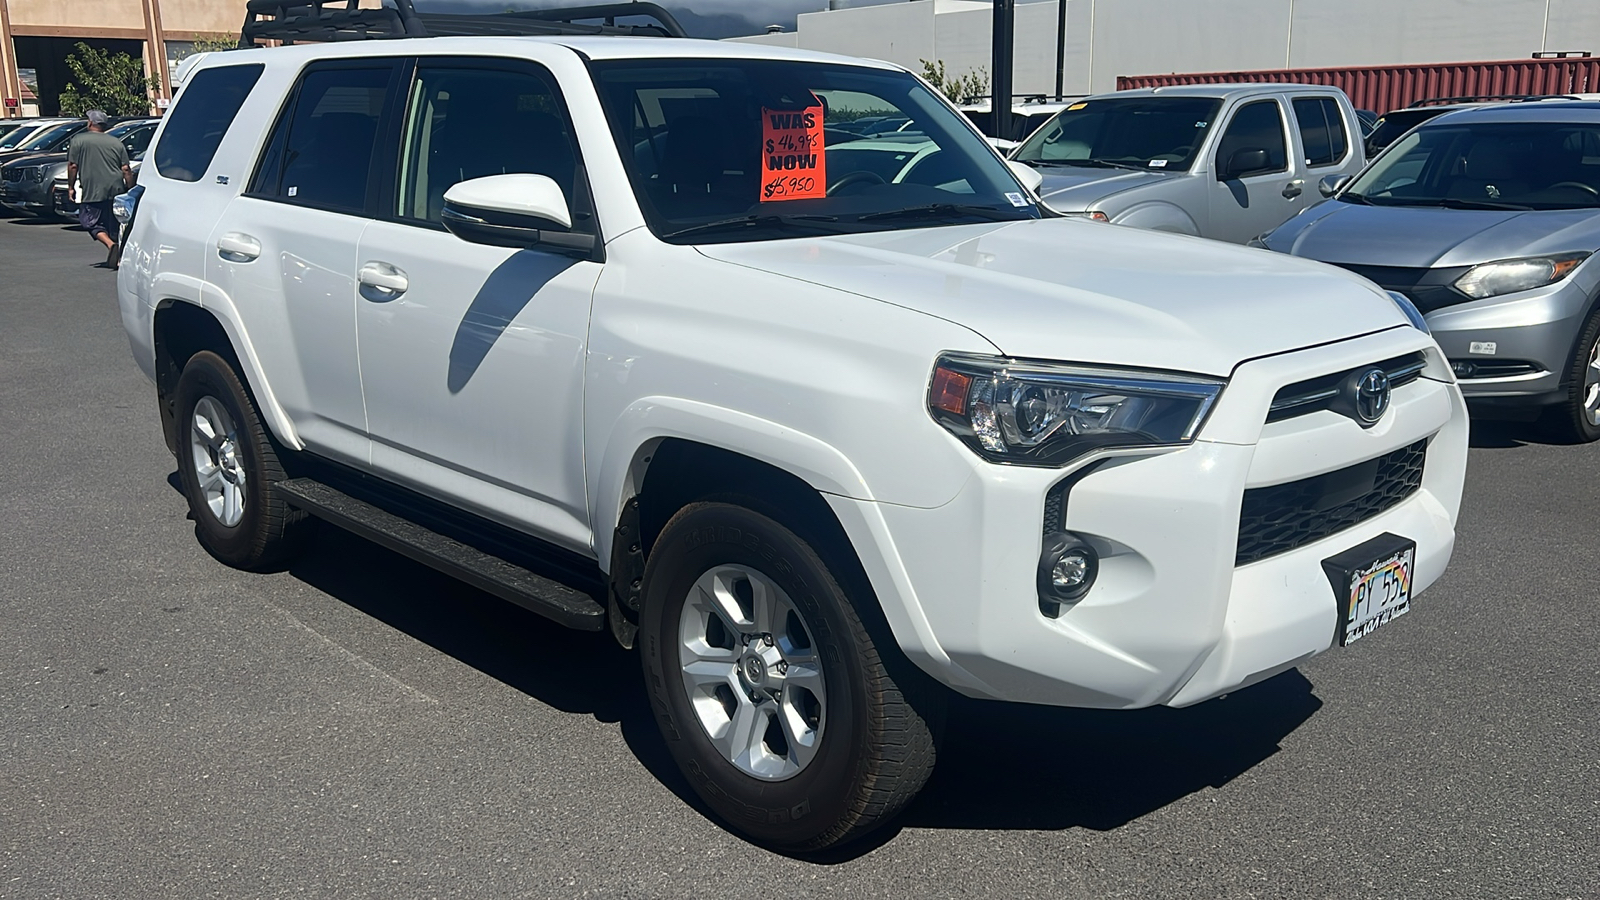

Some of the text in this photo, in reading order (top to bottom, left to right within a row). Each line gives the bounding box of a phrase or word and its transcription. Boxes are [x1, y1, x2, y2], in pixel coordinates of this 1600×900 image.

[770, 113, 815, 130] WAS
[769, 154, 817, 171] NOW
[683, 524, 843, 666] BRIDGESTONE
[1381, 561, 1408, 607] 552
